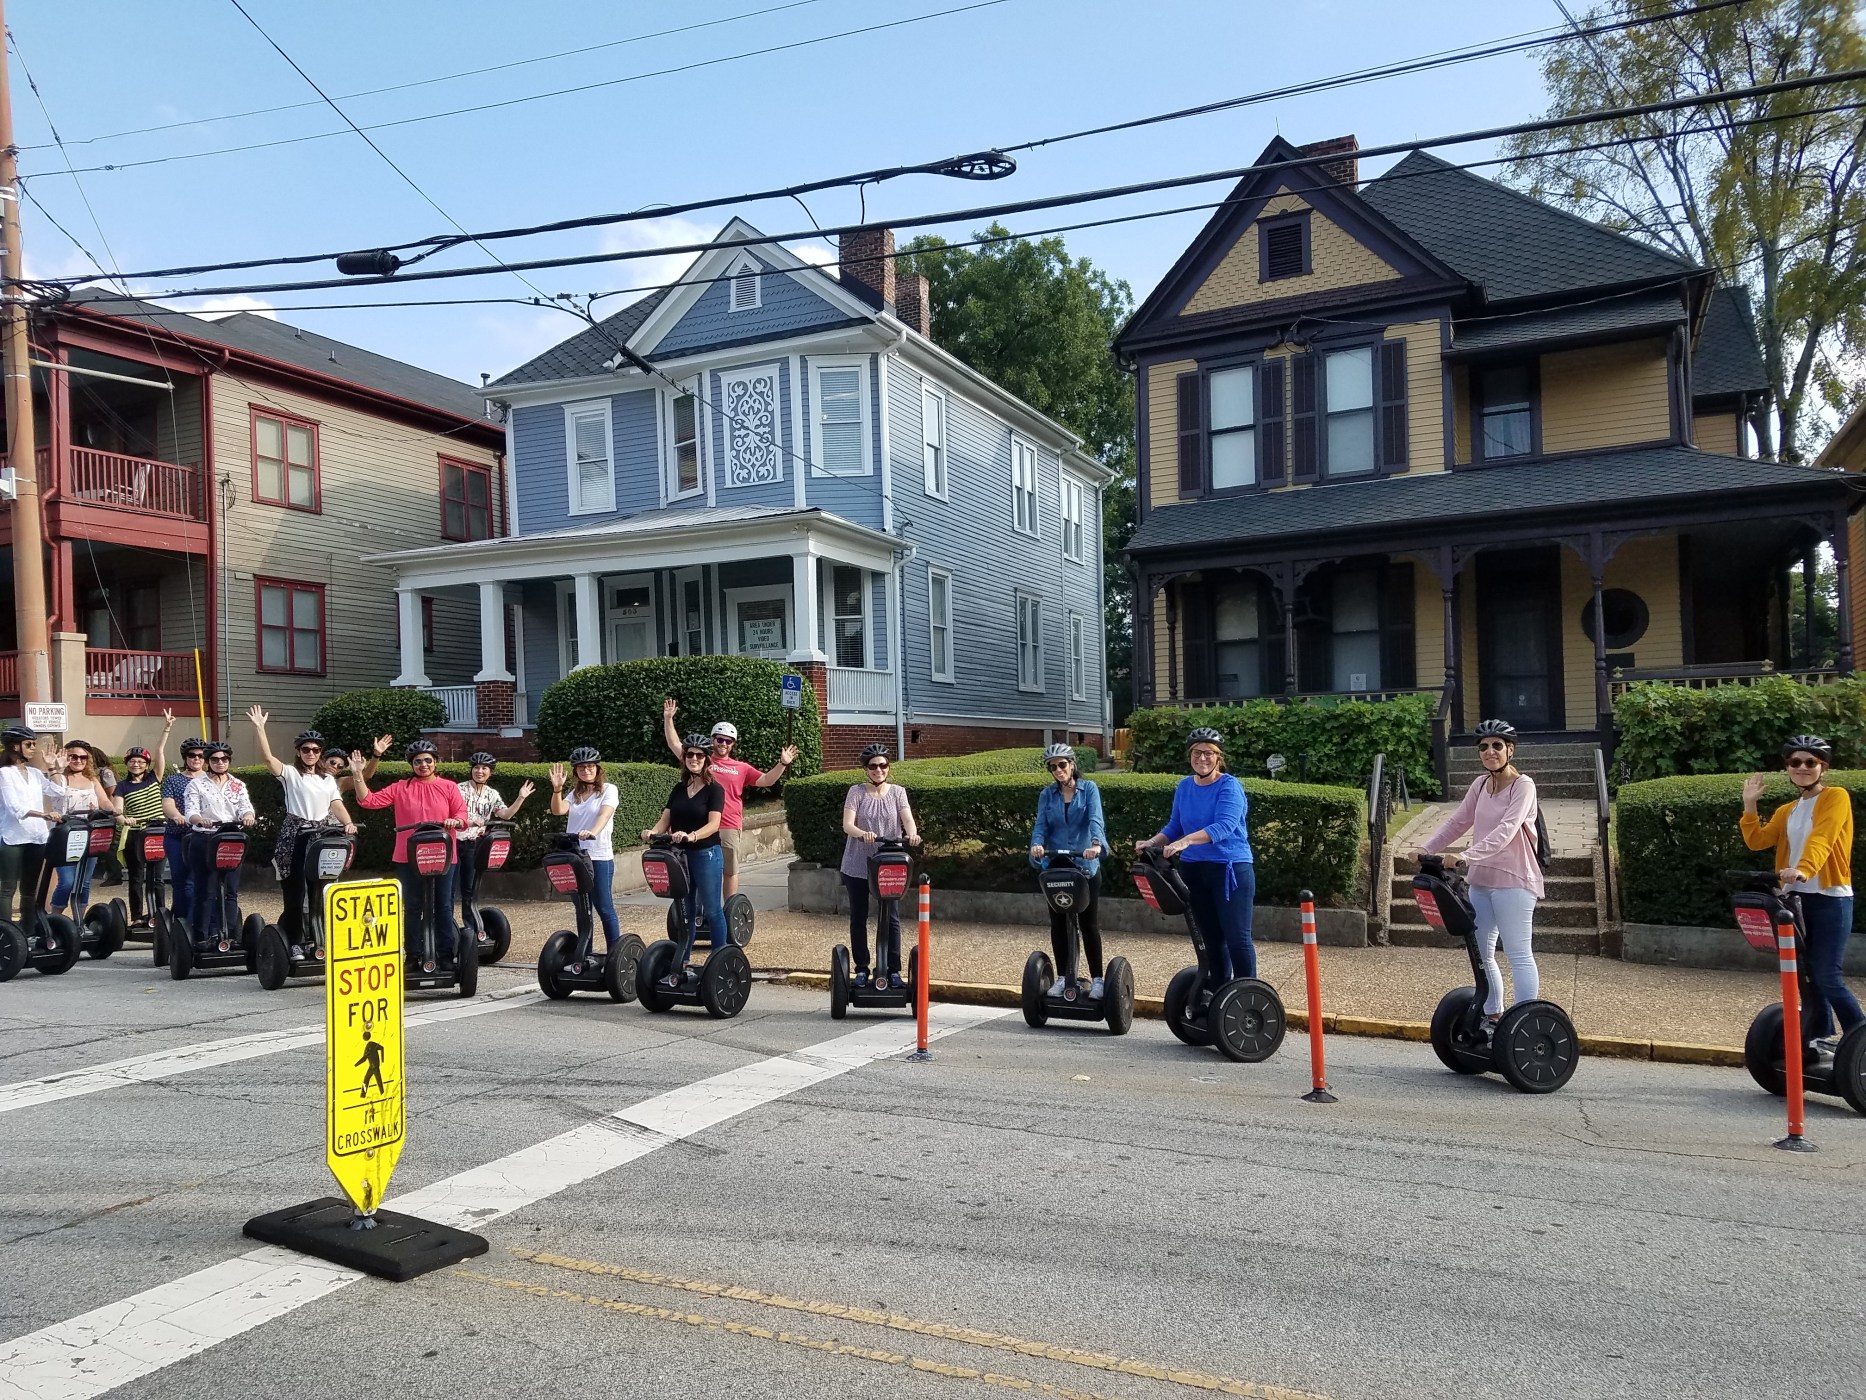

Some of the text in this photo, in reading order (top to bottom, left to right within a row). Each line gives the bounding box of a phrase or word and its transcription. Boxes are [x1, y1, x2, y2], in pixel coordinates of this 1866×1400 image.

[28, 707, 65, 716] NO PARKING
[335, 892, 397, 922] STATE
[348, 922, 389, 951] LAW
[339, 963, 396, 996] STOP
[348, 997, 389, 1028] FOR
[364, 1109, 376, 1125] IN
[337, 1121, 399, 1150] CROSSWALK
